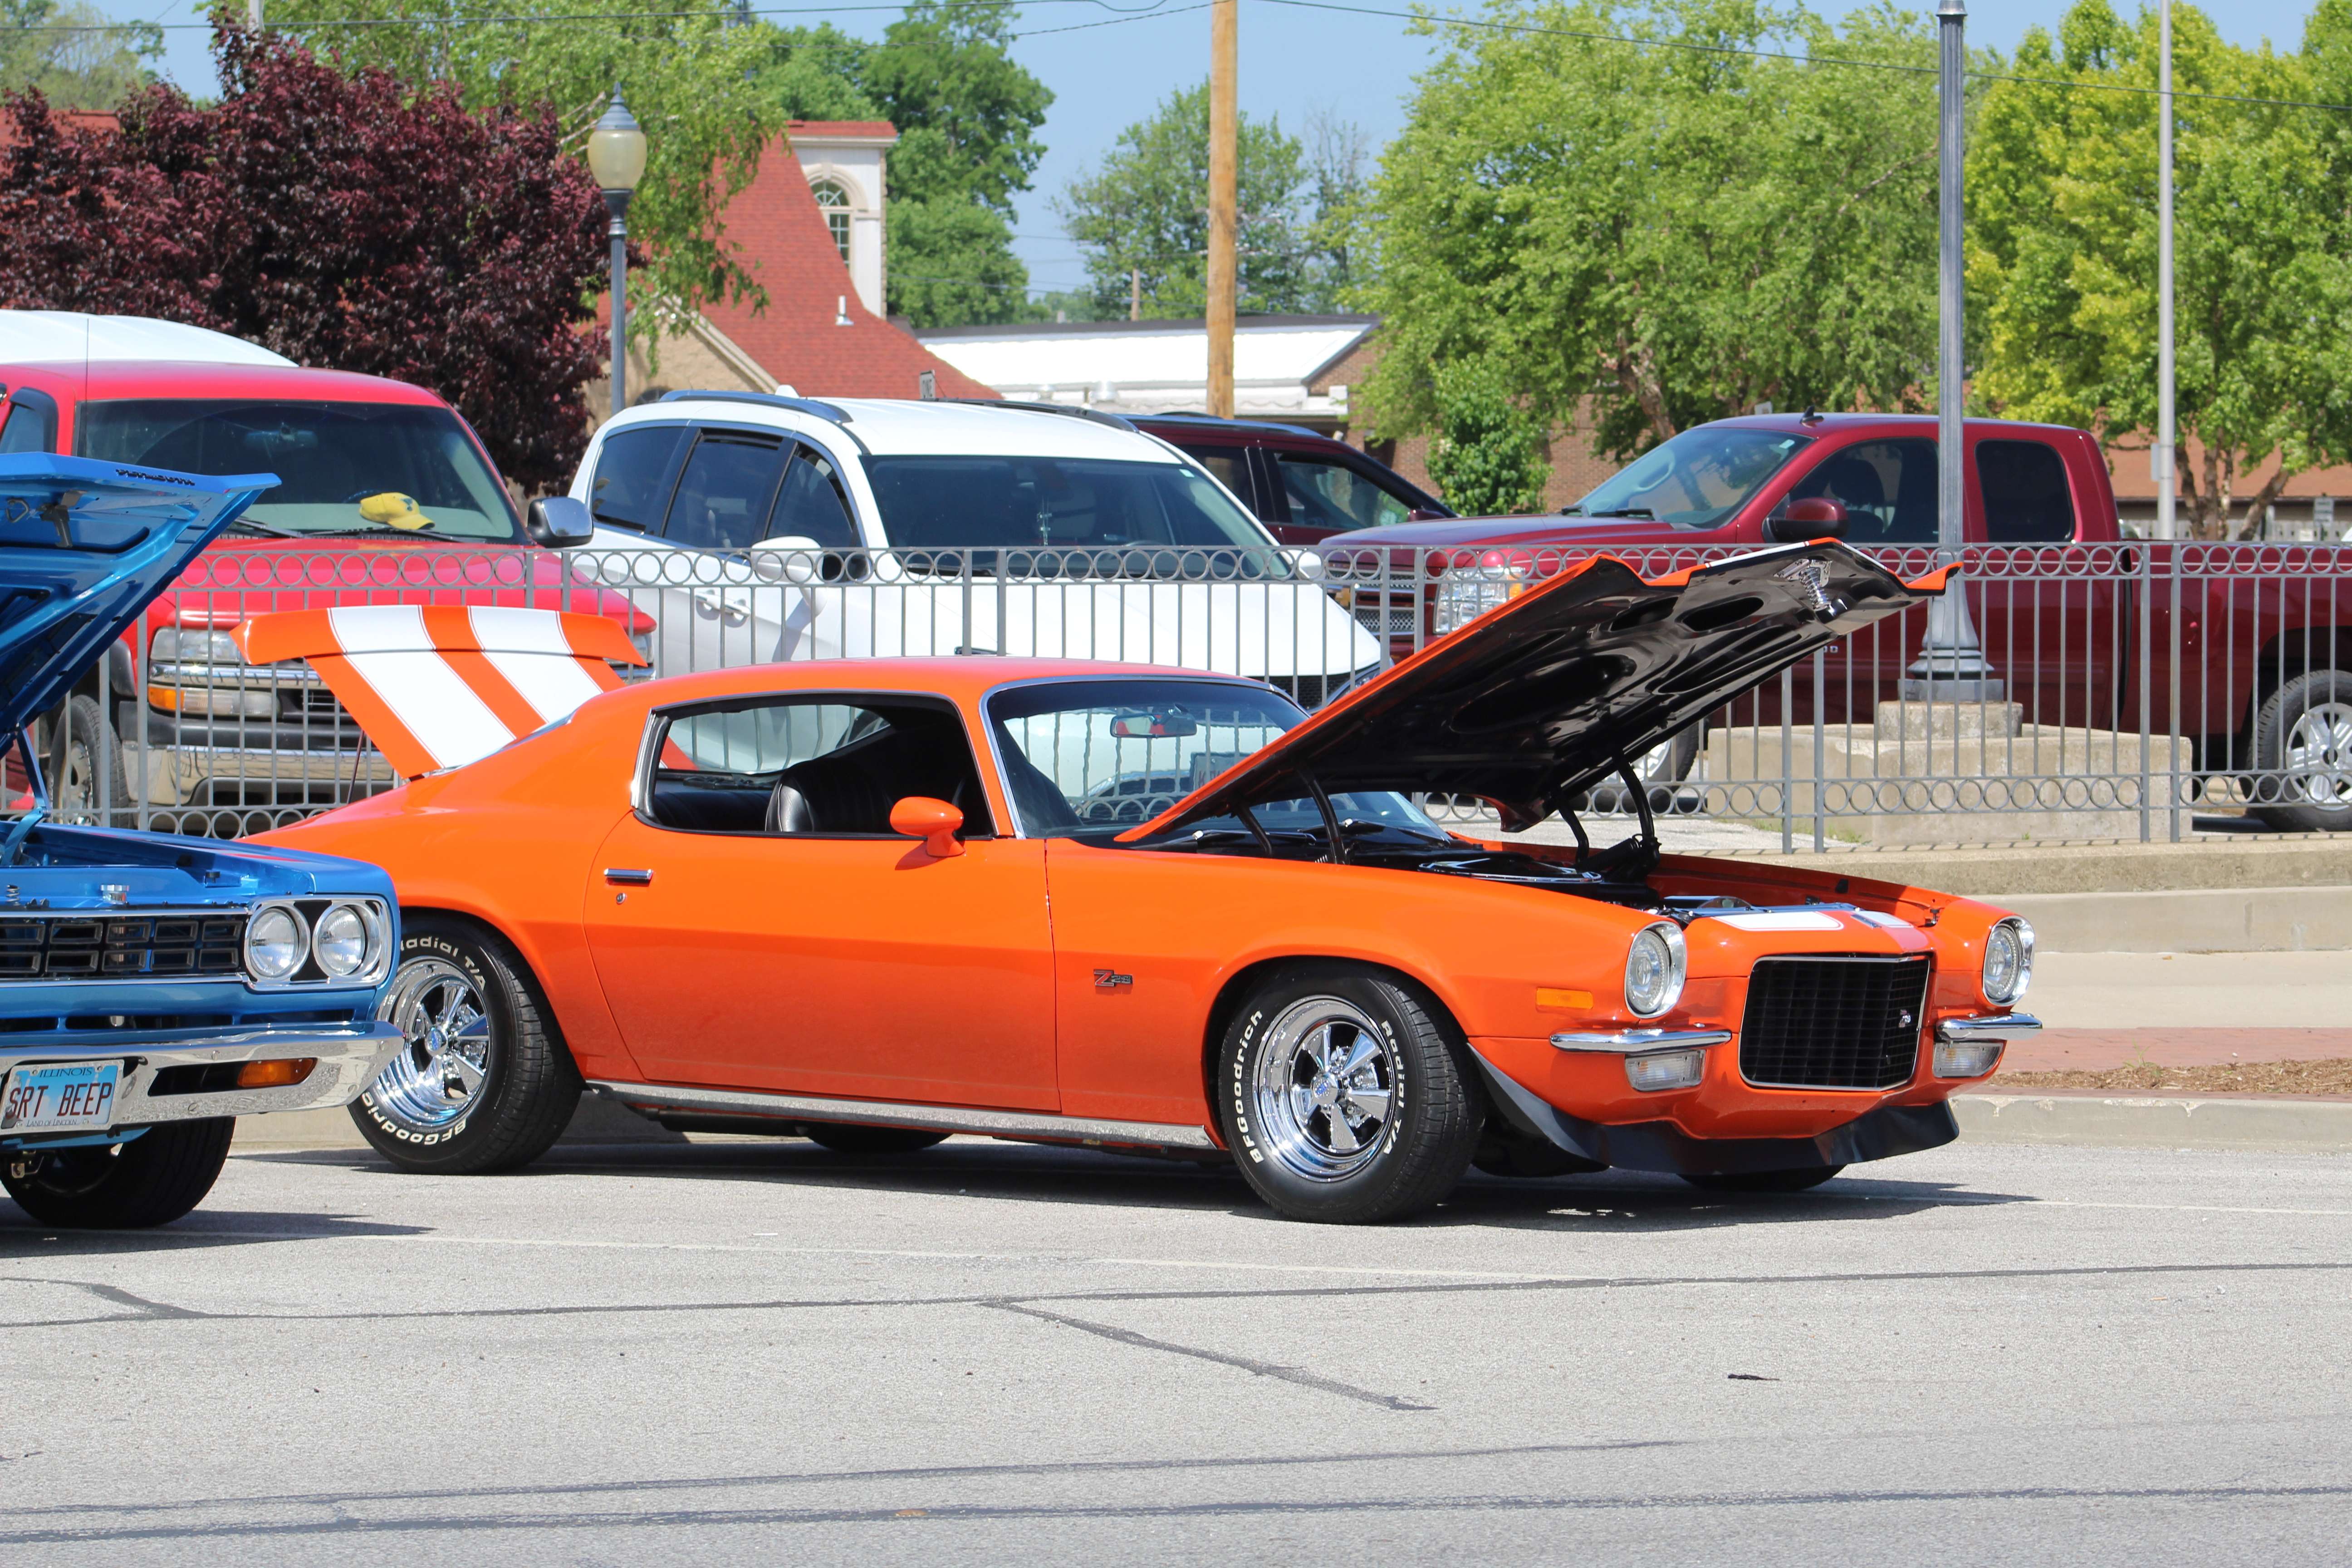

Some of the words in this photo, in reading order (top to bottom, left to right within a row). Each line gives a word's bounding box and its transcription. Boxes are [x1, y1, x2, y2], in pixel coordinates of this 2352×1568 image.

[465, 956, 486, 990] T/A
[1093, 969, 1132, 987] Z28
[39, 1067, 93, 1078] ILLINOIS
[1381, 1020, 1405, 1108] Radial
[5, 1085, 49, 1119] SRT
[57, 1082, 113, 1117] BEEP
[1233, 1010, 1264, 1164] BFGoodrich
[26, 1119, 43, 1127] LAND
[362, 1092, 466, 1145] BFGoodric
[1383, 1119, 1402, 1155] T/A
